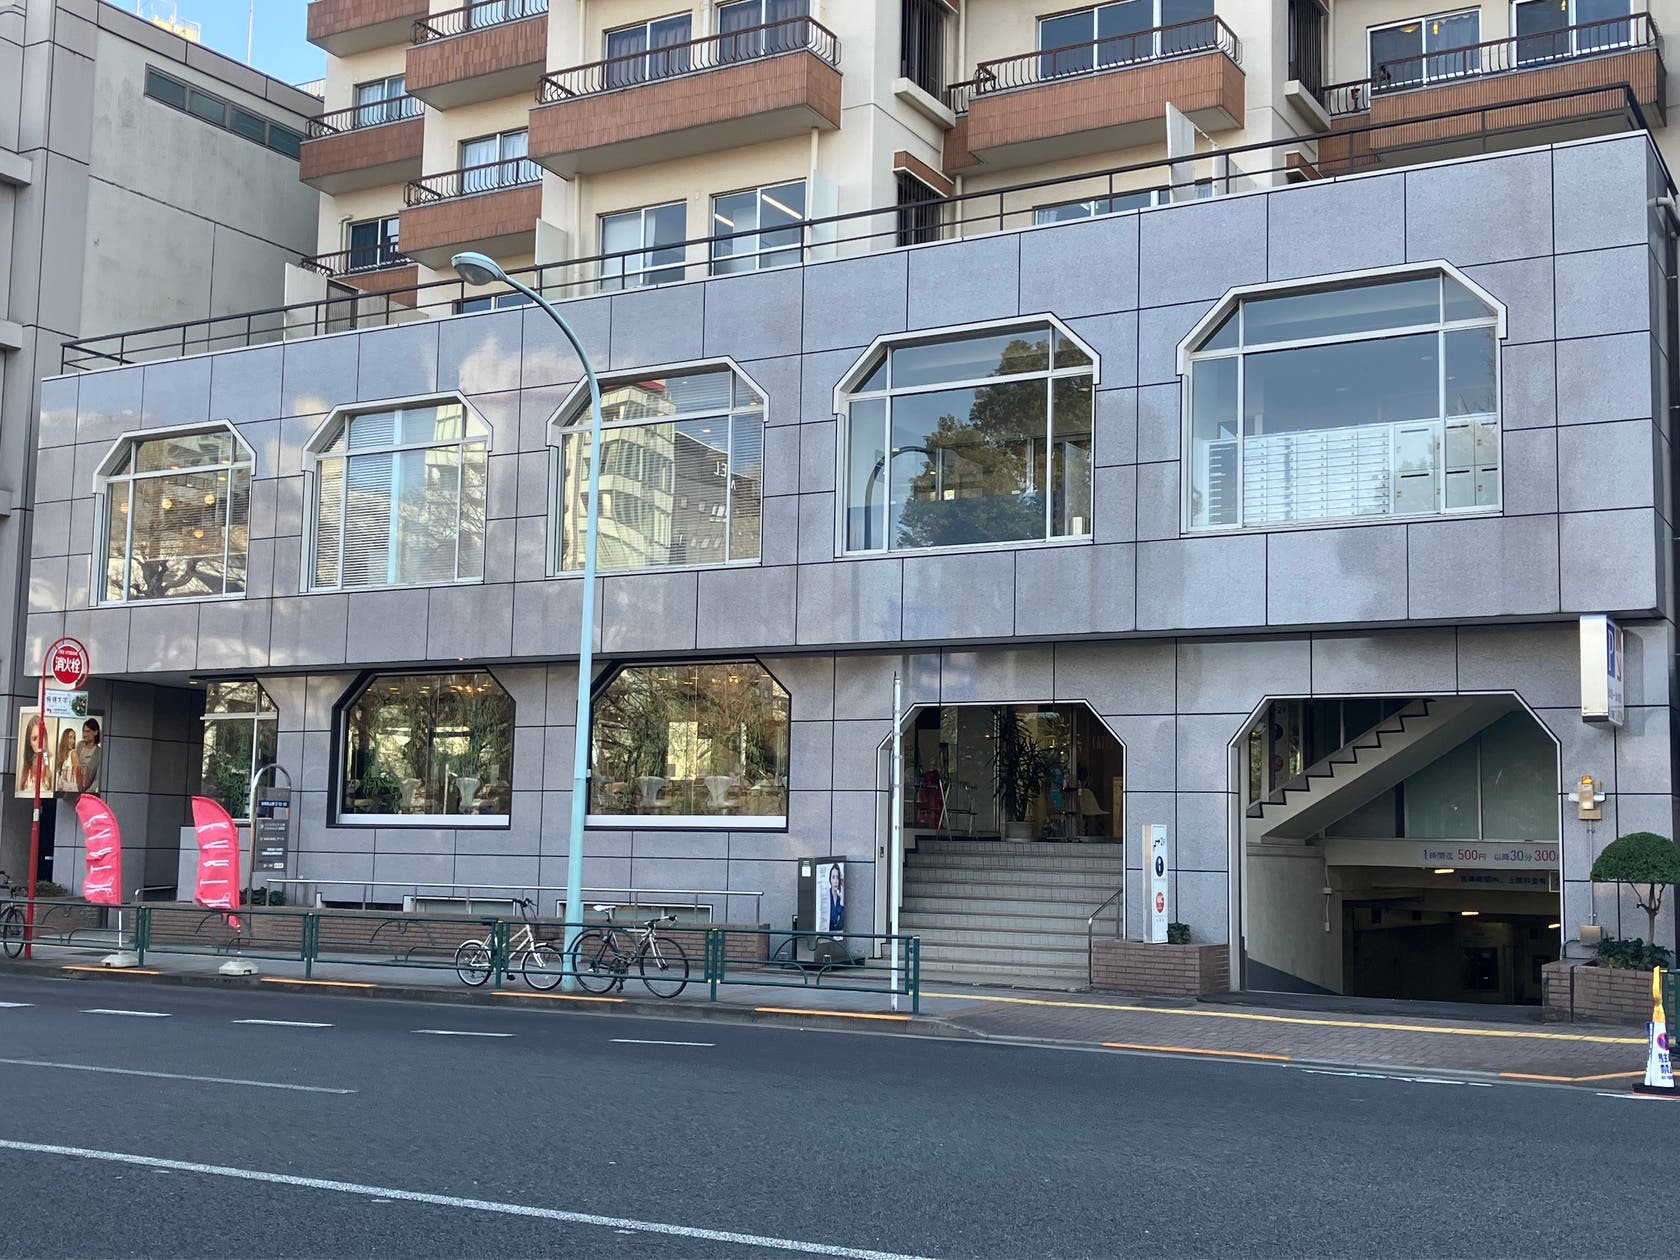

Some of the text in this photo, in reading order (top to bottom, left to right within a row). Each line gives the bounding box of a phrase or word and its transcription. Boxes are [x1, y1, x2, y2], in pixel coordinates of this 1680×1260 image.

[54, 656, 81, 674] 消火栓
[1458, 849, 1487, 860] 500円
[1534, 849, 1560, 862] 300
